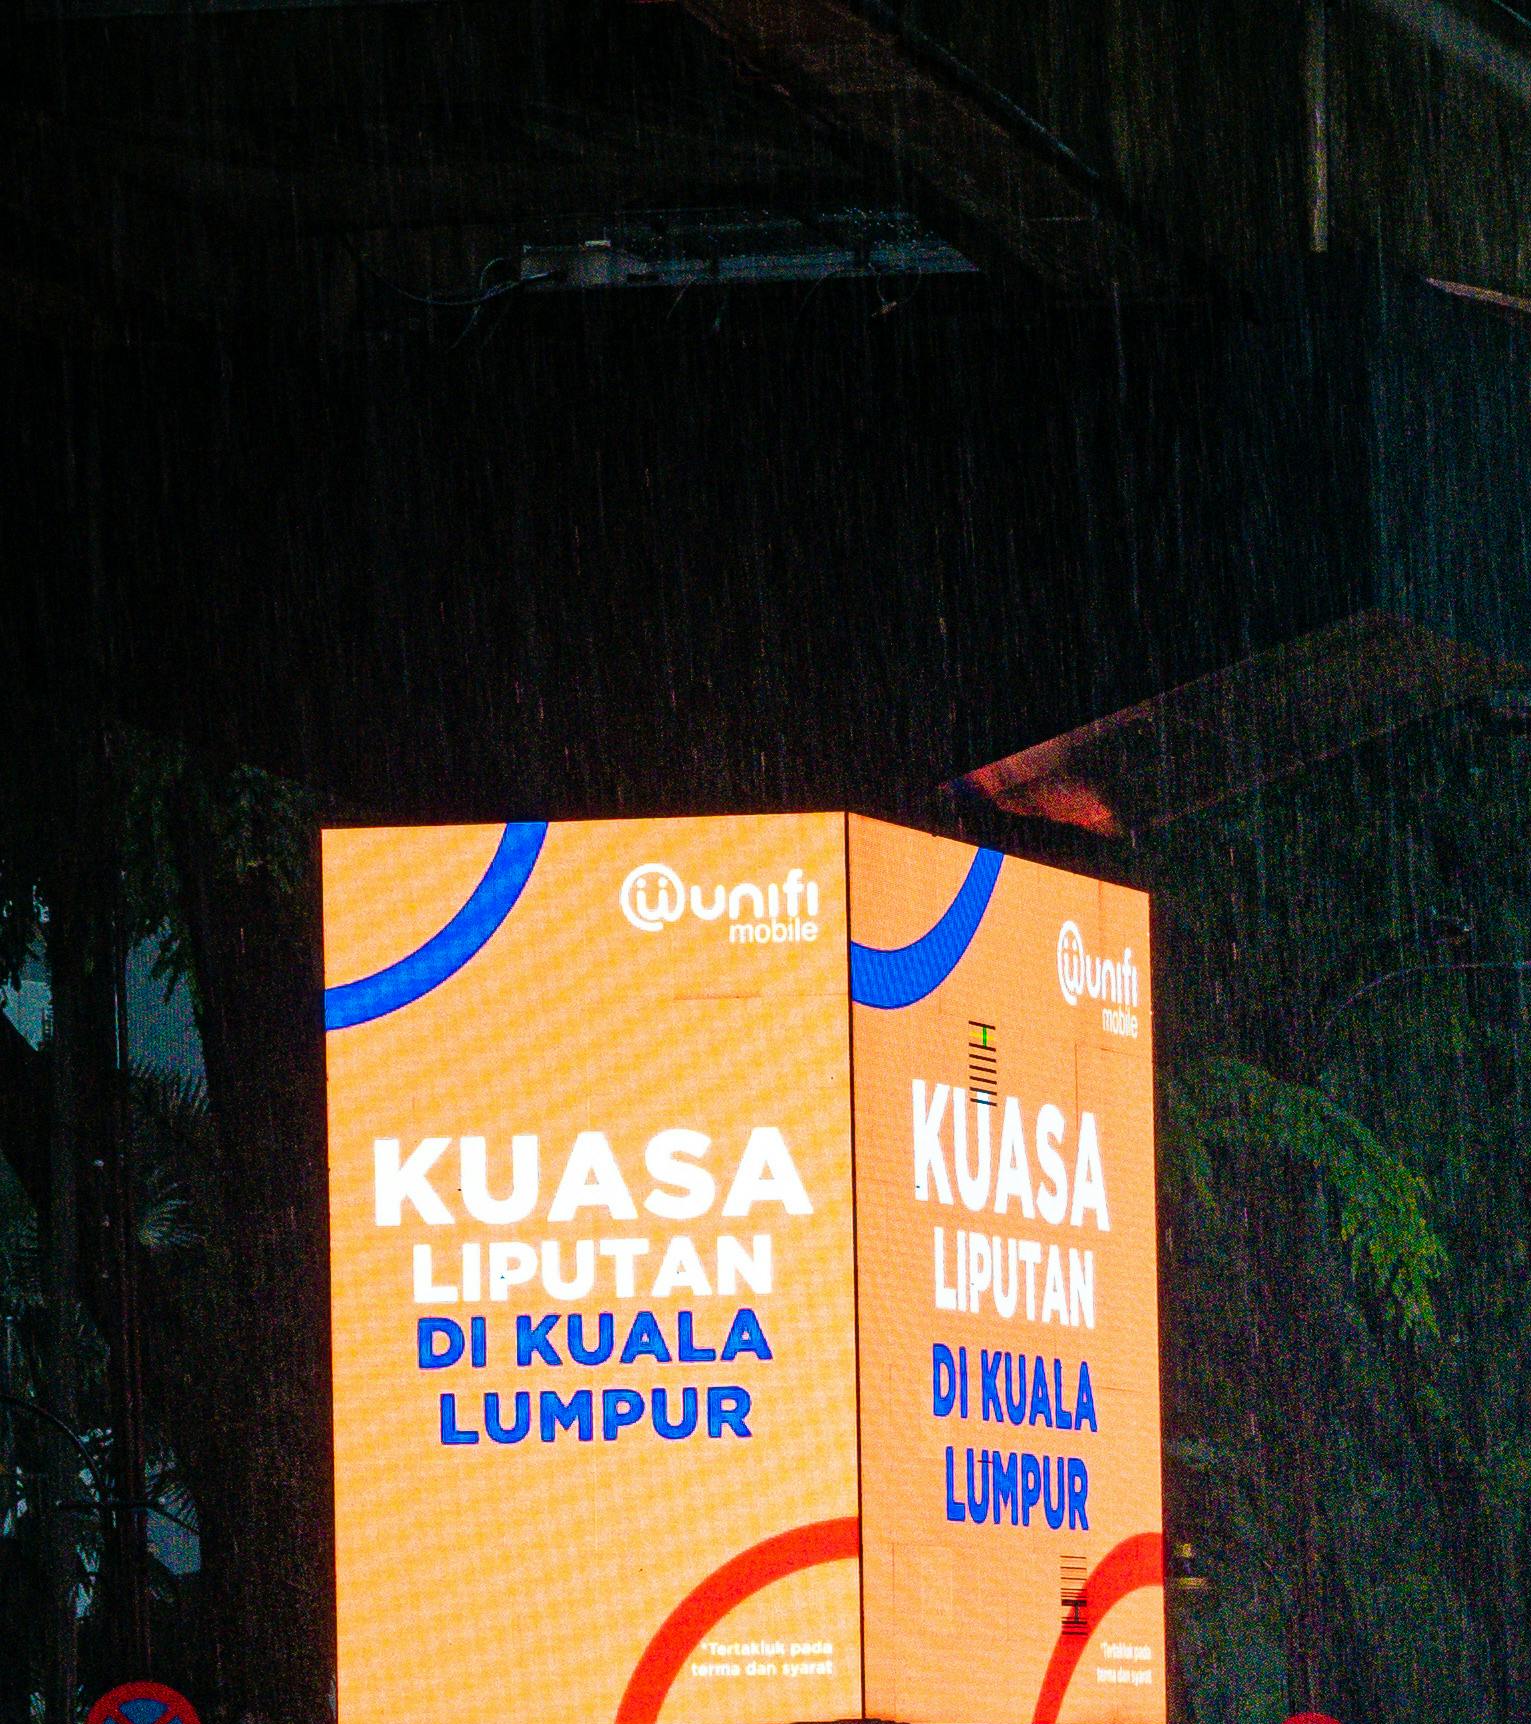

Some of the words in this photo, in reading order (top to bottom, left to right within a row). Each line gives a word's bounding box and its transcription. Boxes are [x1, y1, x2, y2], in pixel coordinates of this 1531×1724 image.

[690, 868, 819, 920] unifi
[729, 917, 818, 943] mobile
[1085, 947, 1138, 1008] unifi
[1102, 1004, 1138, 1038] mobile
[373, 1126, 814, 1227] KUASA
[912, 1079, 1110, 1232] KUASA
[412, 1234, 774, 1304] LIPUTAN
[933, 1227, 1096, 1330] LIPUTAN
[417, 1316, 487, 1369] DI
[515, 1308, 773, 1367] KUALA
[440, 1385, 752, 1446] LUMPUR
[932, 1342, 968, 1419] DI
[980, 1349, 1098, 1433] KUALA
[945, 1444, 1090, 1531] LUMPUR
[746, 1660, 776, 1677] dan
